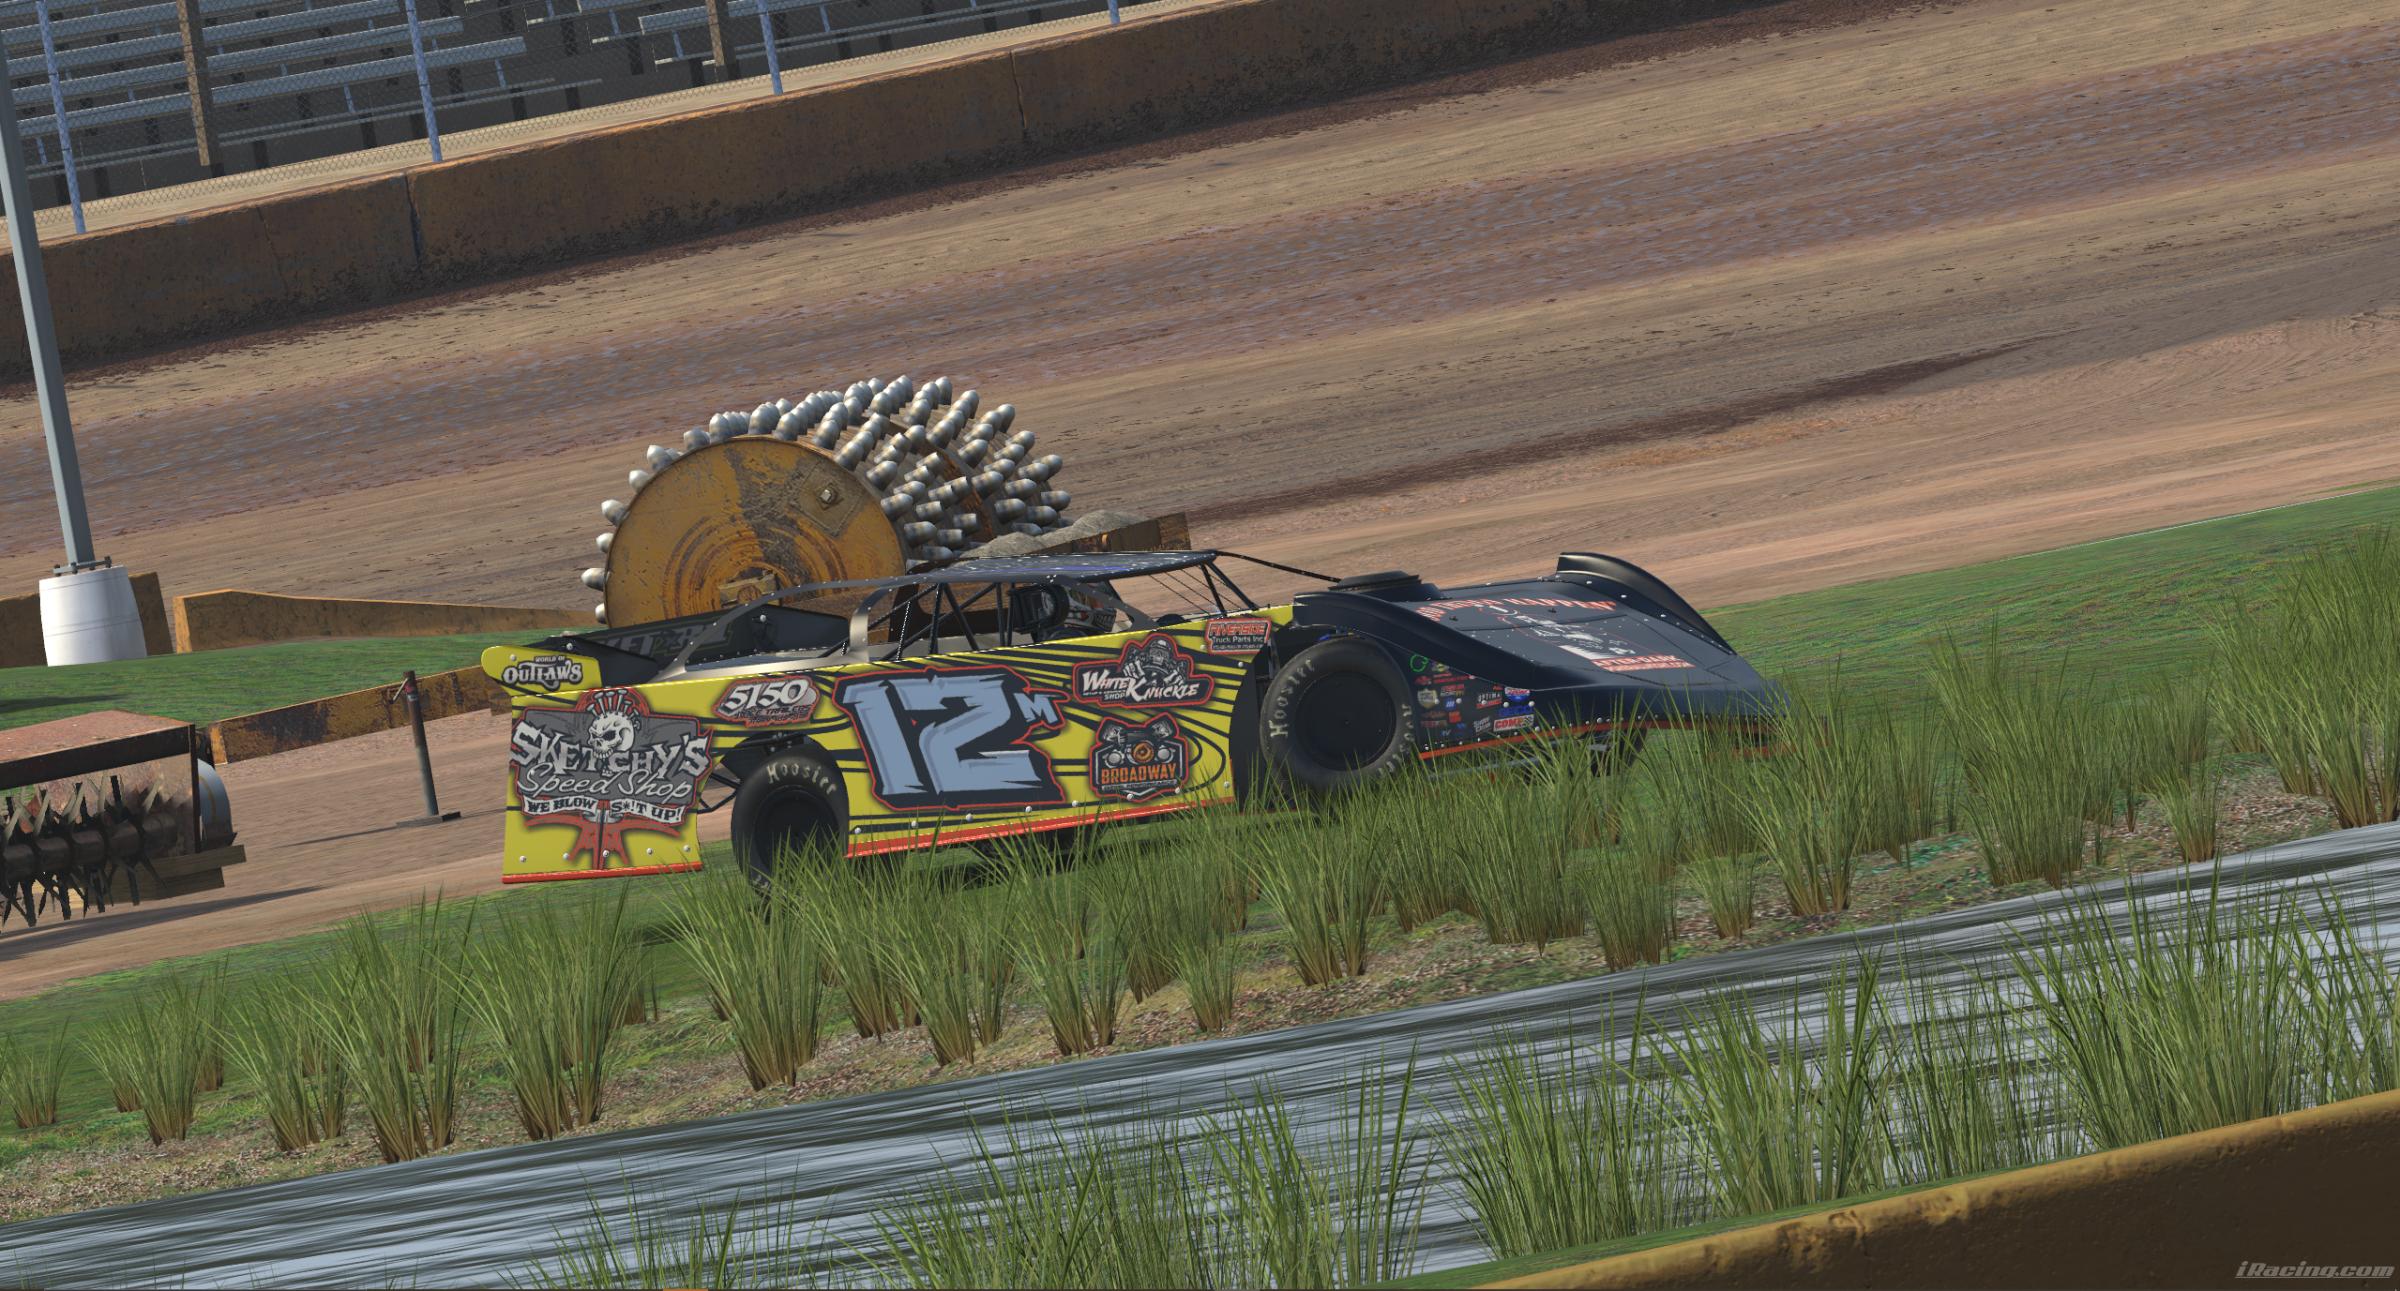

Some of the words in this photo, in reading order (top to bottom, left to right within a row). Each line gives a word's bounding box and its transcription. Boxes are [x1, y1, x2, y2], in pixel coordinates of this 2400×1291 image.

[1210, 623, 1265, 636] RIVERSIDE
[502, 660, 583, 689] OUTLAWS
[1082, 669, 1130, 692] WHITE
[1125, 678, 1200, 702] KNUCKLE
[722, 679, 810, 712] 5150
[511, 721, 711, 778] SKETCHY'S
[517, 761, 624, 798] Speed
[617, 769, 692, 804] Shop
[766, 761, 837, 795] Hoosier
[1101, 763, 1177, 785] BROADWAY
[527, 800, 550, 813] WE
[552, 797, 595, 811] BLOW
[650, 806, 683, 822] UP!
